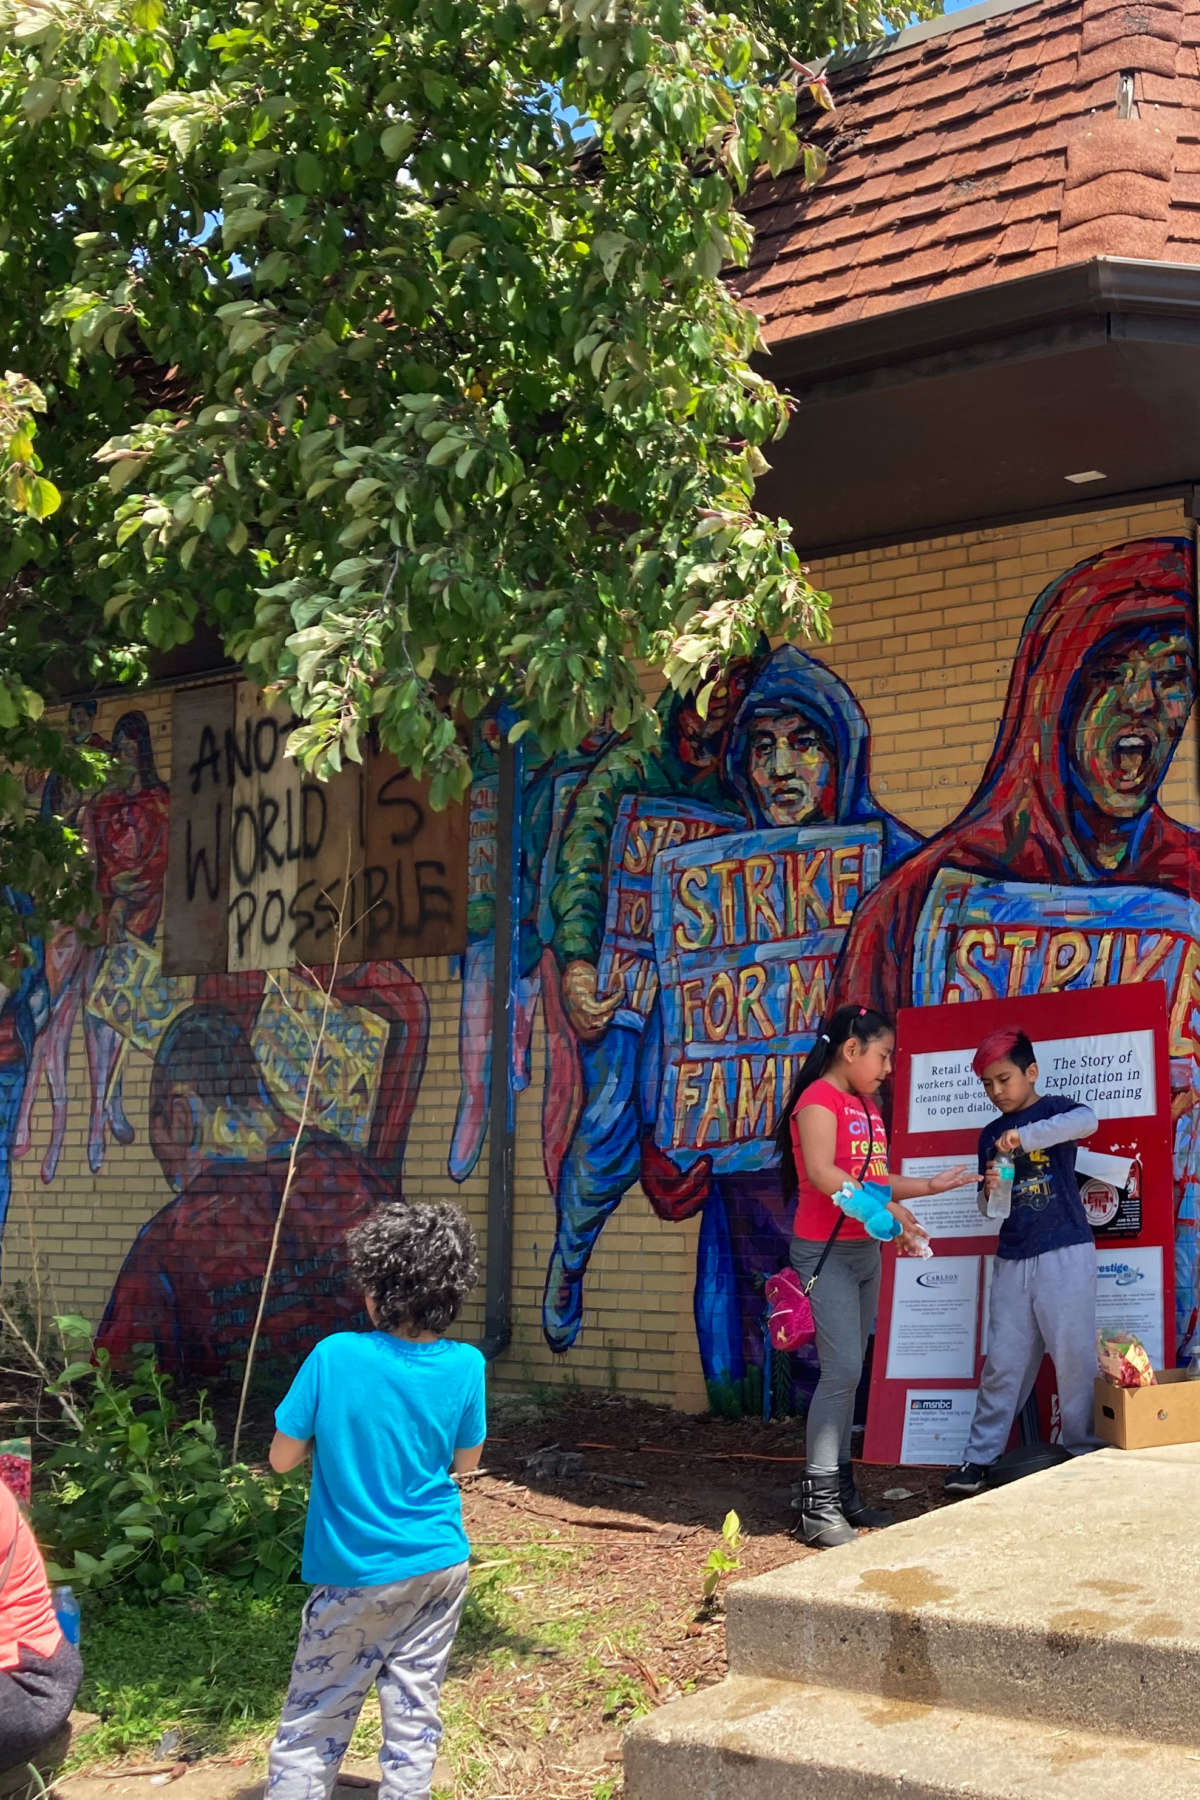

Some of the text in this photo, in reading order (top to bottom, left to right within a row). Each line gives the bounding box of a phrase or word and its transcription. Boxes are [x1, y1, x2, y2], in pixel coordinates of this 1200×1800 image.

[185, 767, 425, 901] WORLD IS
[675, 846, 862, 951] STRIKE
[227, 858, 454, 957] POSSIBLE
[682, 958, 828, 1043] FOR M
[1053, 1050, 1133, 1070] The Story of
[931, 1063, 961, 1076] Retail
[917, 1080, 954, 1090] workers
[957, 1077, 974, 1087] call
[1045, 1068, 1140, 1090] Exploitation in
[915, 1093, 951, 1104] cleaning
[1085, 1087, 1142, 1102] Cleaning
[927, 1101, 997, 1116] to open dialog
[922, 1399, 951, 1409] msnbc
